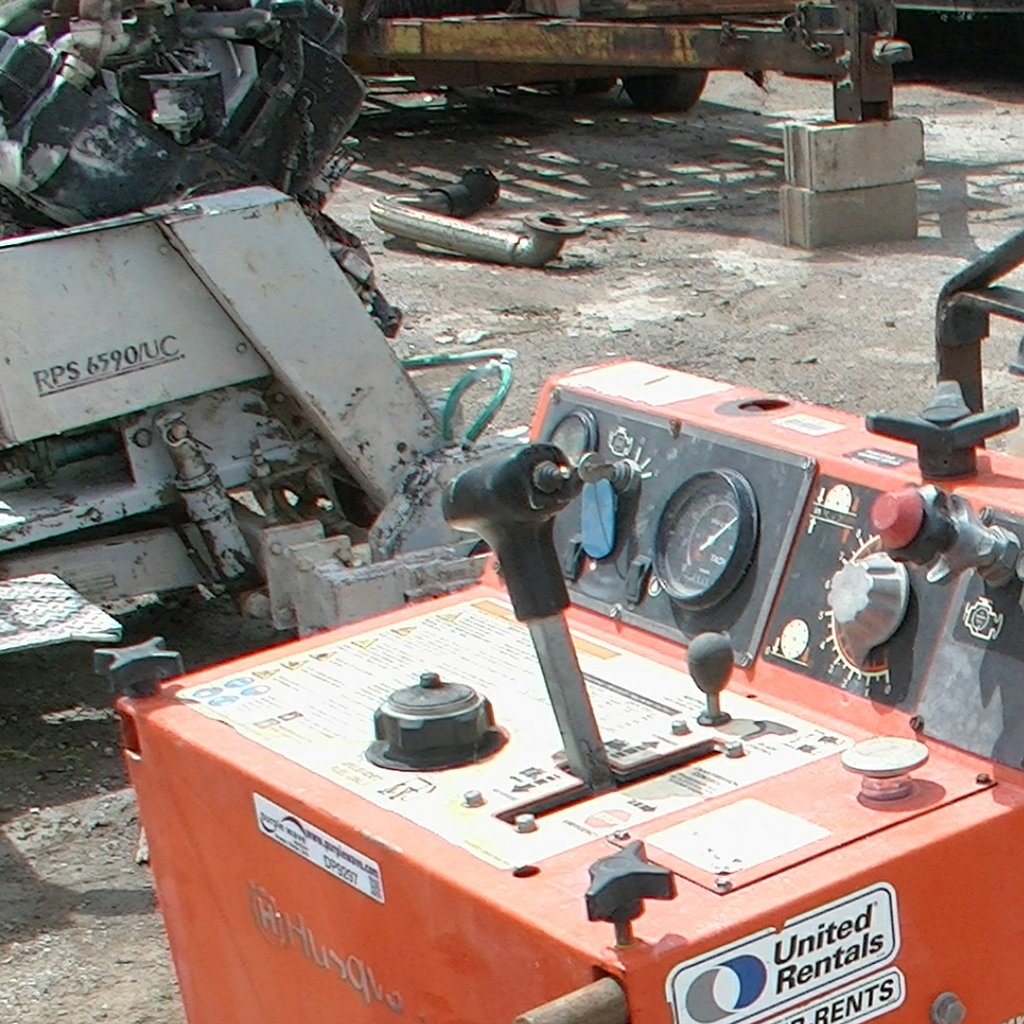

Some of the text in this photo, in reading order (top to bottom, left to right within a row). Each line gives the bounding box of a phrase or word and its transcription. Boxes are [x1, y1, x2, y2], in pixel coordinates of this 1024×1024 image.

[33, 335, 180, 391] RPS 6590/UC
[774, 903, 873, 966] United
[776, 933, 884, 996] Rentals
